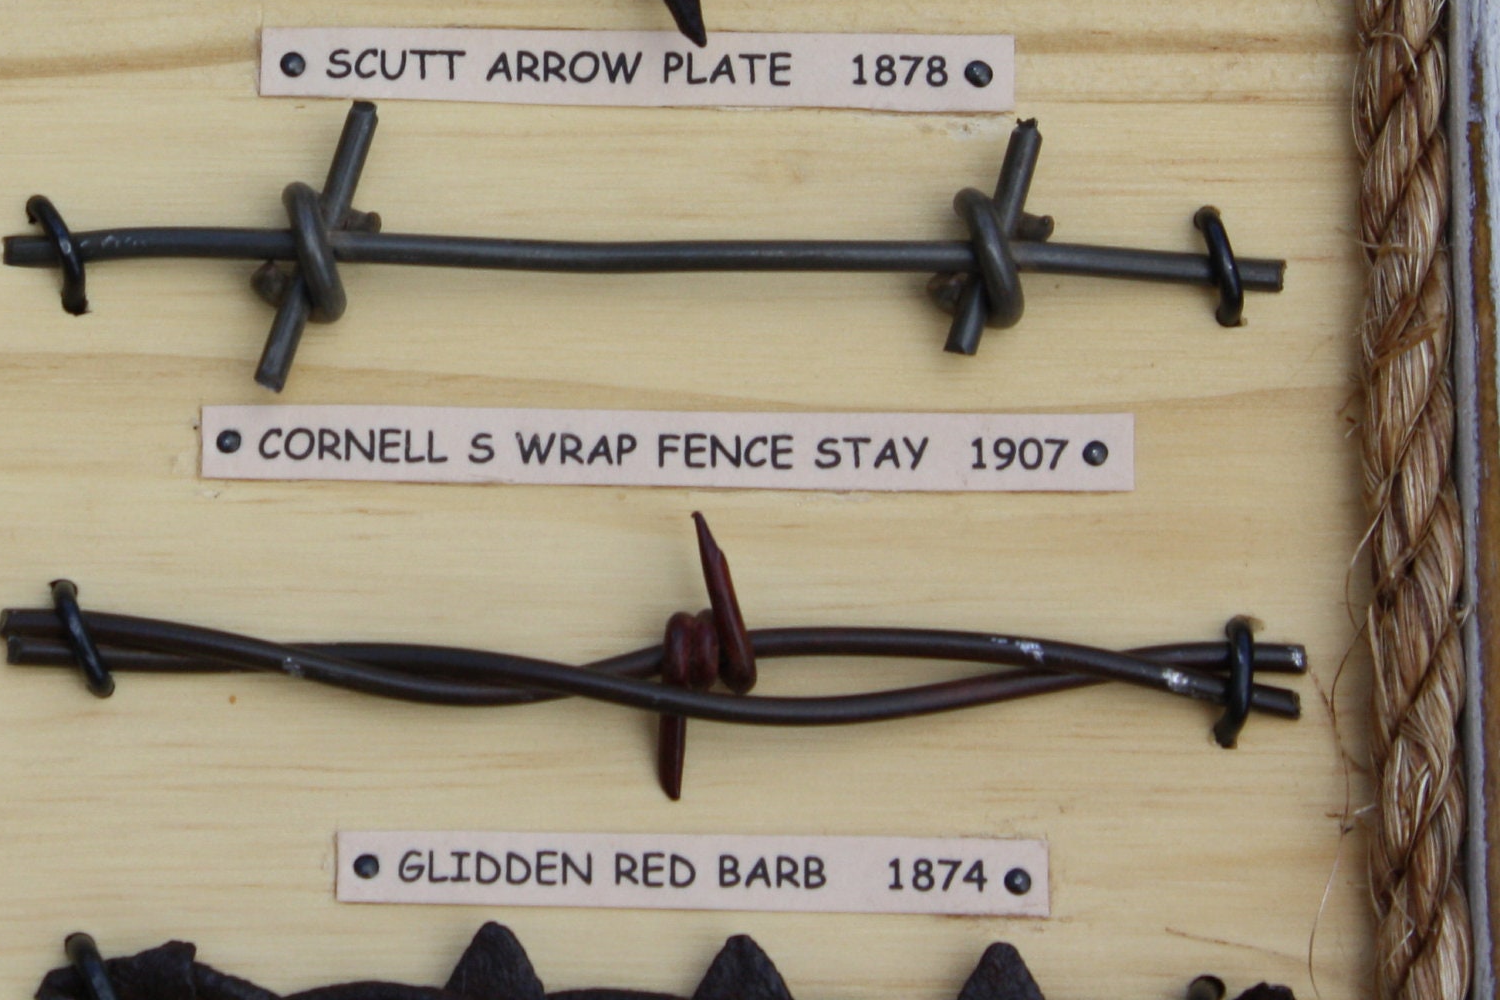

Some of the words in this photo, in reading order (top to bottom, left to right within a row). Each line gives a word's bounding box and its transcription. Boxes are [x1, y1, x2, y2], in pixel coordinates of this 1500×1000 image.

[325, 48, 467, 81] SCUTT
[486, 50, 643, 85] ARROW
[663, 51, 792, 87] PLATE
[852, 53, 949, 88] 1878
[258, 427, 448, 465] CORNELL
[468, 432, 495, 464] S
[515, 431, 638, 466] WRAP
[658, 432, 794, 470] FENCE
[814, 436, 929, 471] STAY
[971, 437, 1069, 471] 1907
[398, 850, 593, 886] GLIDDEN
[614, 852, 697, 889] RED
[718, 854, 827, 890] BARB
[888, 858, 988, 893] 1874
